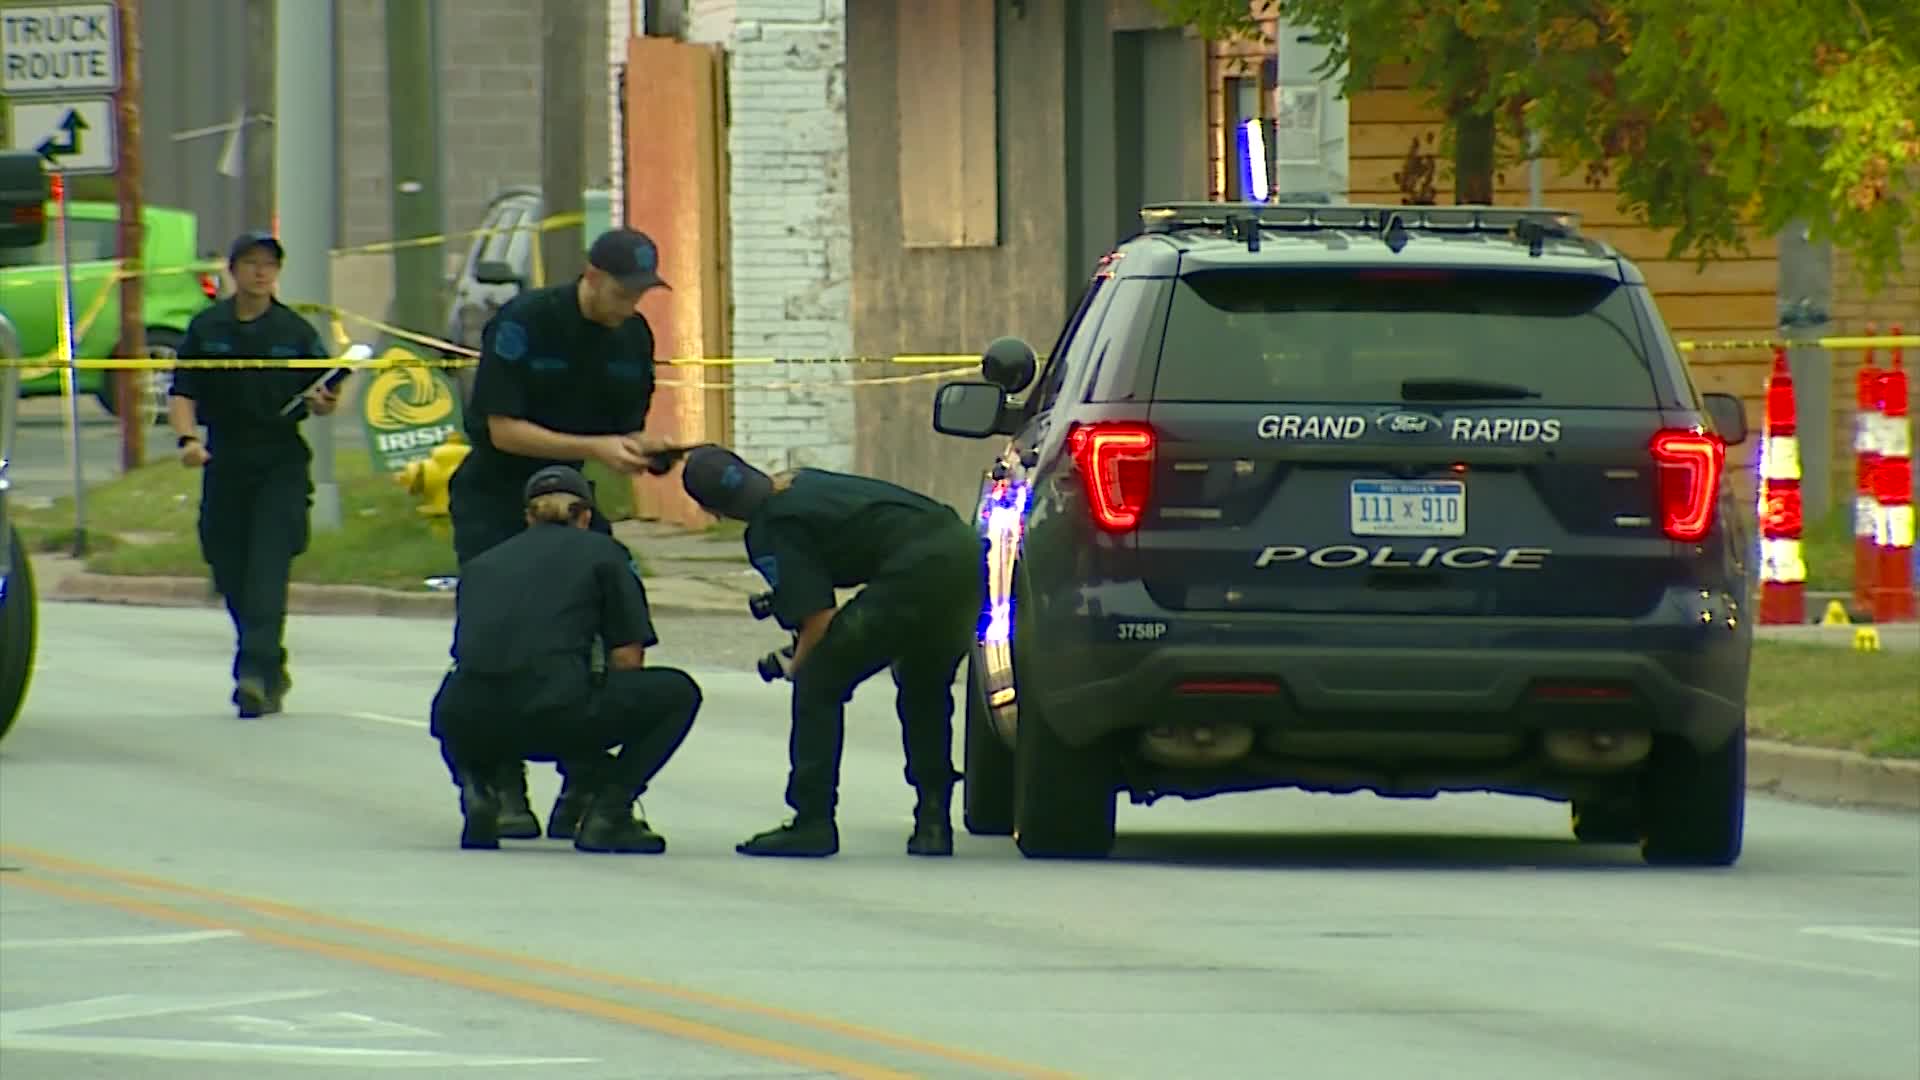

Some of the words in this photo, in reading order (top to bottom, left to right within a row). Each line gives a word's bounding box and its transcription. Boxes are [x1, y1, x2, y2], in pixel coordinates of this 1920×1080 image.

[6, 15, 107, 45] TRUCK
[8, 50, 106, 80] ROUTE
[1257, 415, 1366, 439] GRAND
[1450, 418, 1561, 442] RAPIDS
[1359, 496, 1394, 522] 111
[1421, 497, 1458, 523] 910
[1254, 546, 1552, 569] POLICE
[1117, 623, 1167, 639] 3758P
